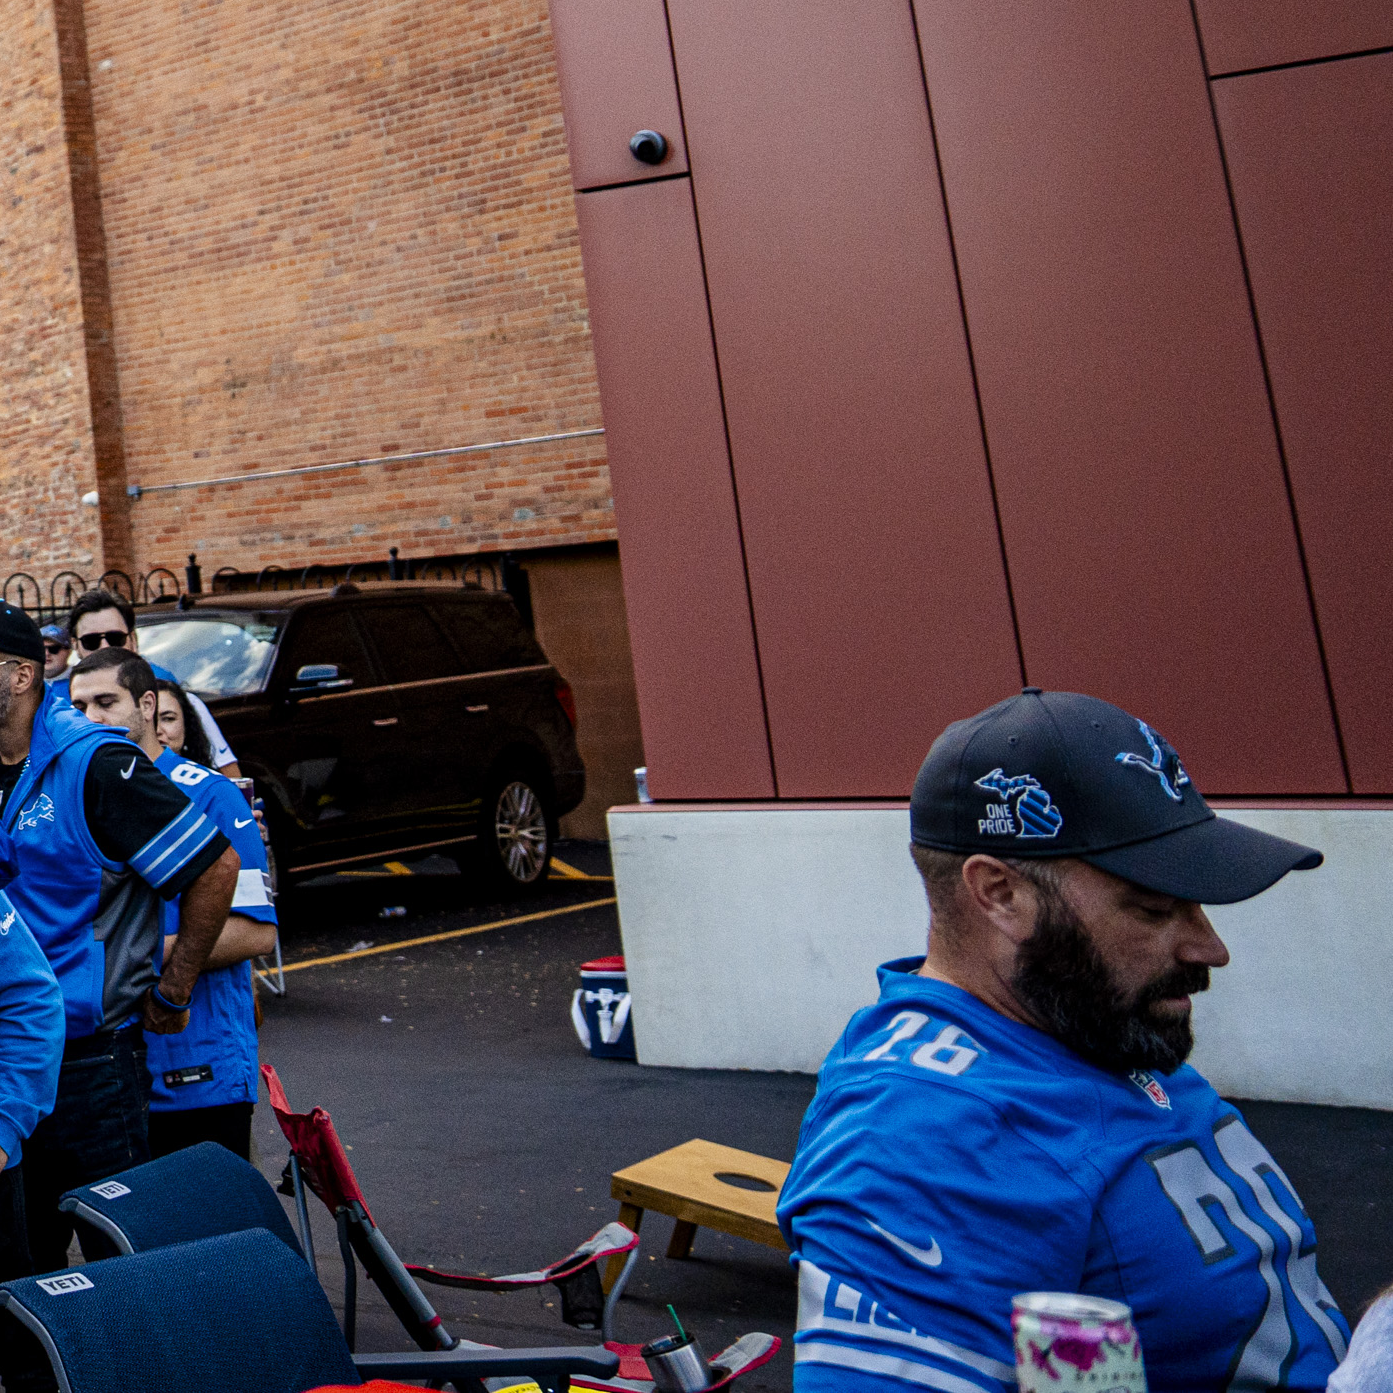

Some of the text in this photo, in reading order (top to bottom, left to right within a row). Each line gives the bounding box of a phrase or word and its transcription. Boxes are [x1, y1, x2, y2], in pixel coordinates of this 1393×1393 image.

[986, 804, 1012, 819] ONE
[978, 819, 1016, 834] PRIDE
[96, 1182, 125, 1197] YETI
[43, 1275, 86, 1292] YETI
